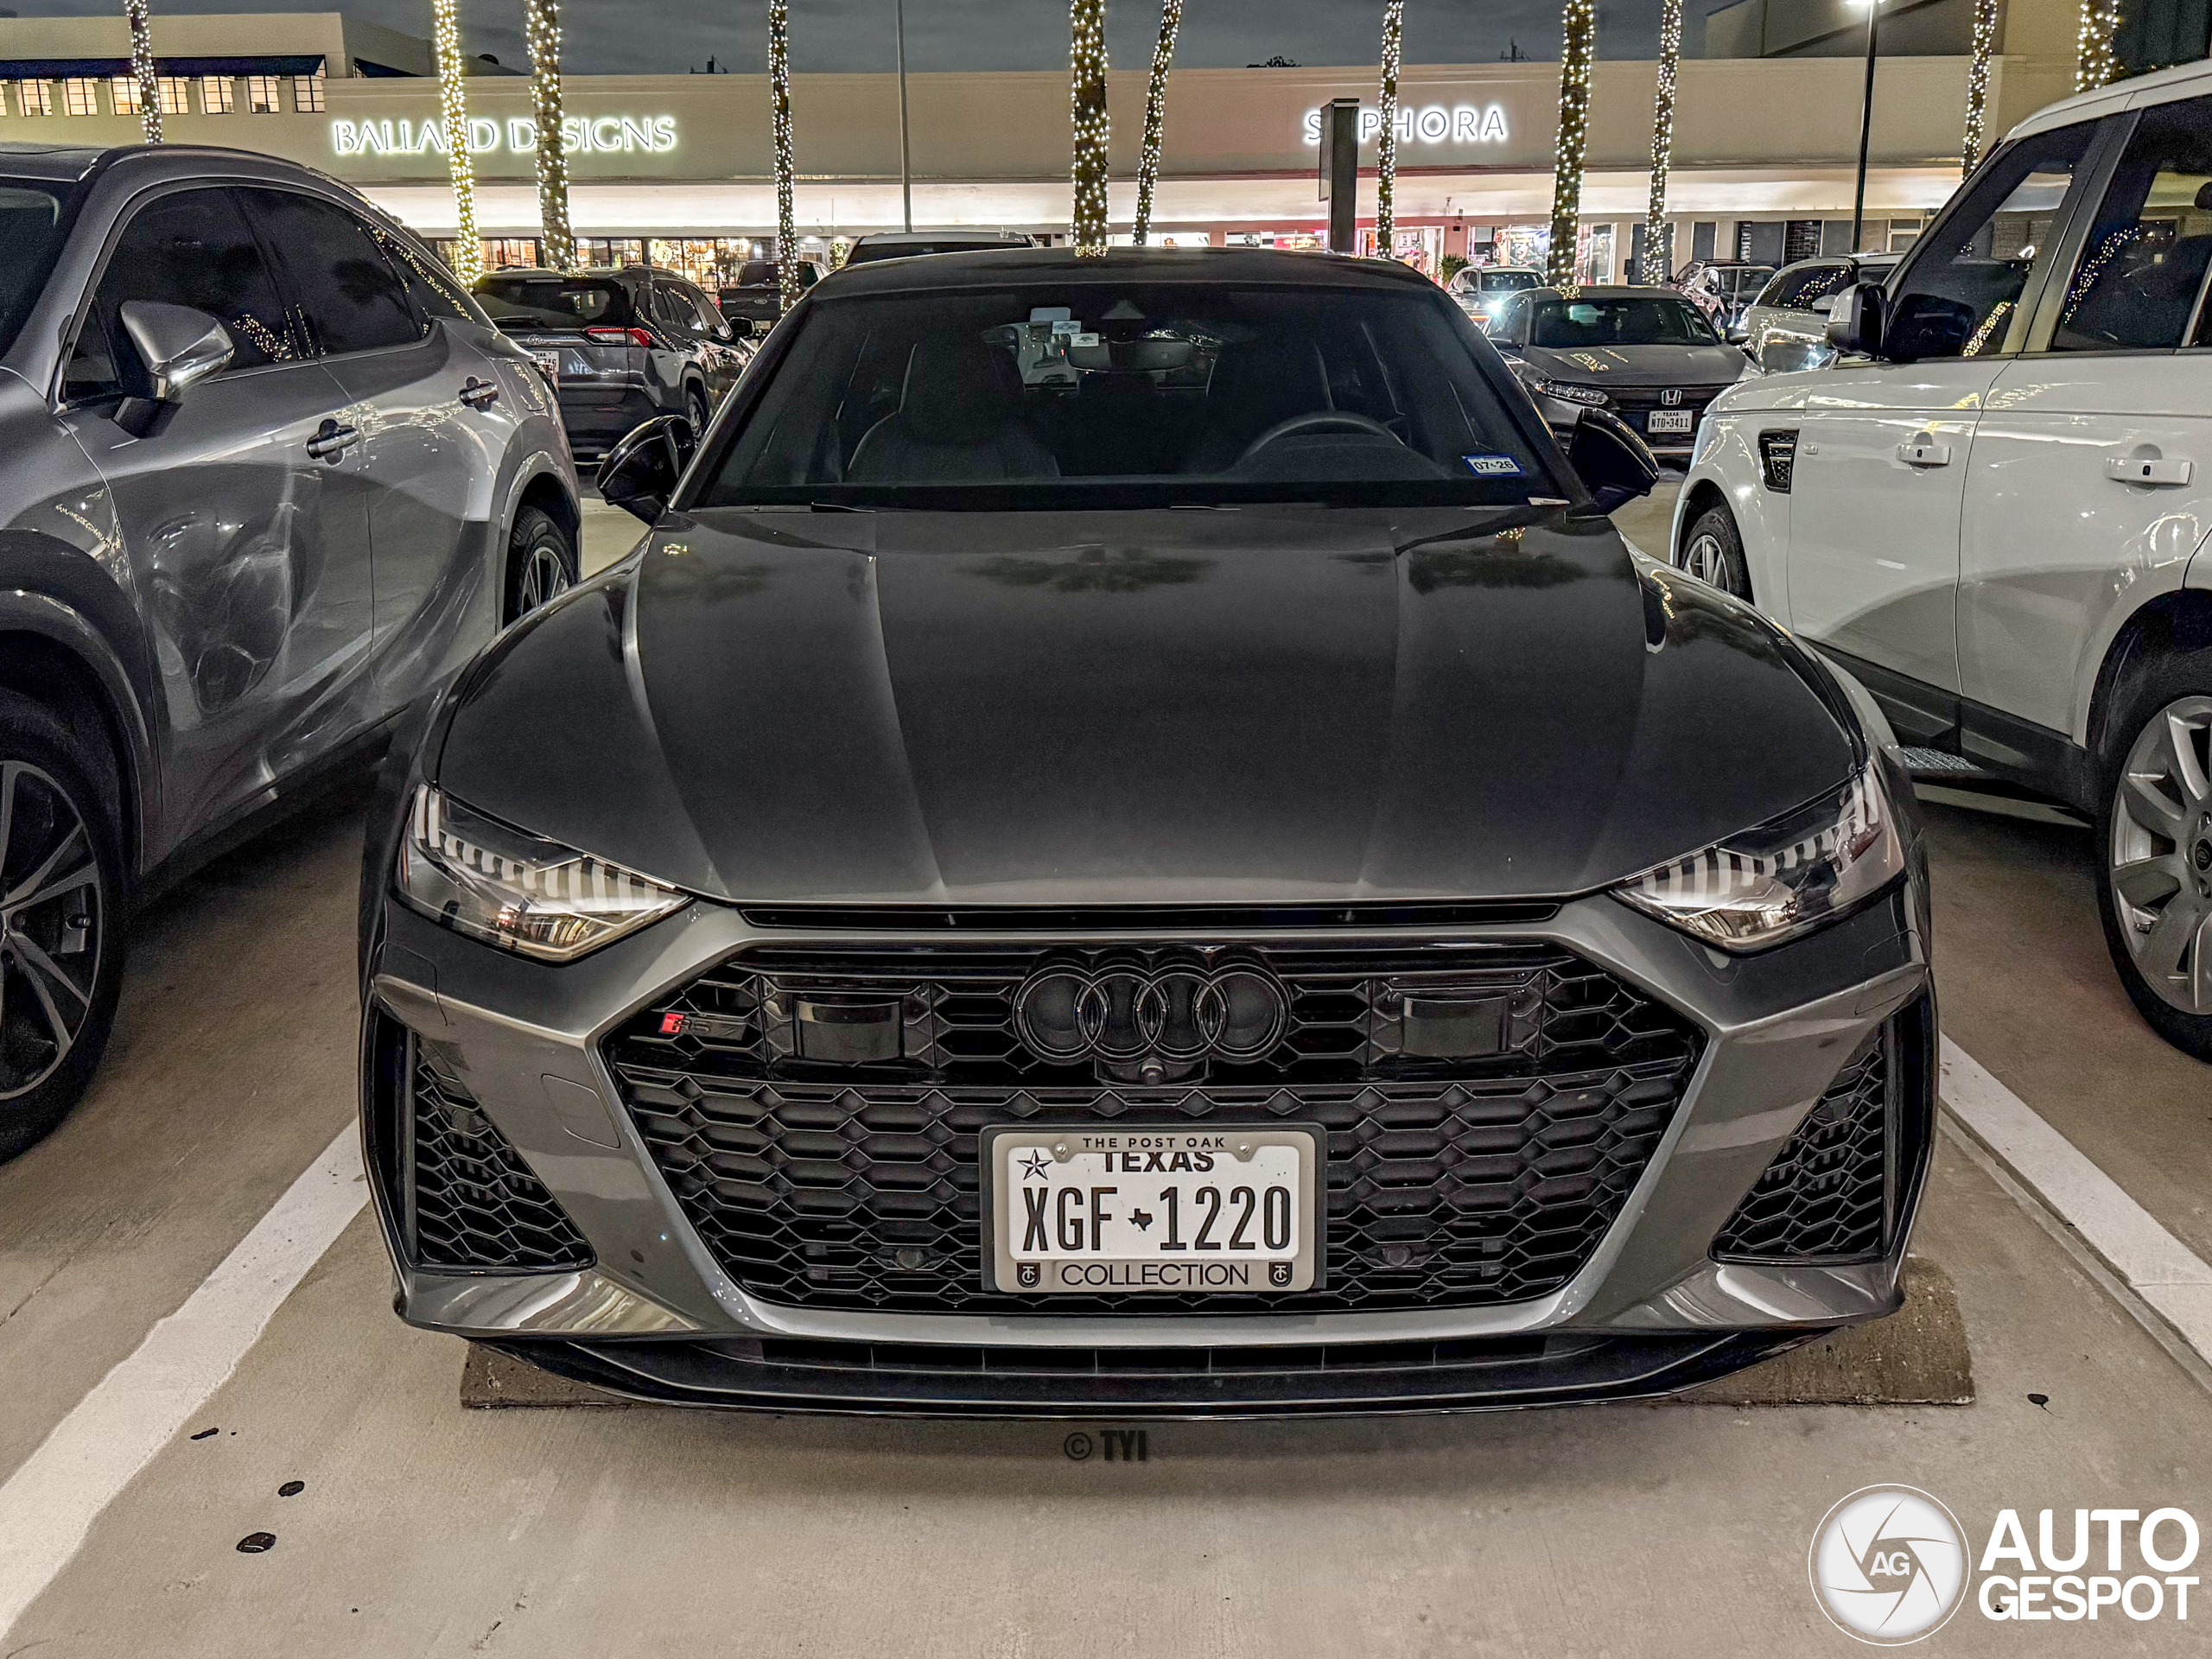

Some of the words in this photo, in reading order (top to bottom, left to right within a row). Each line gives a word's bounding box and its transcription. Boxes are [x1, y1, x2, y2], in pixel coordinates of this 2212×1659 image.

[334, 122, 497, 152] BALLAD
[510, 118, 675, 150] DSIGNS
[1306, 108, 1506, 142] SPHORA
[1083, 1137, 1118, 1148] THE
[1128, 1136, 1176, 1148] POST
[1185, 1136, 1225, 1148] OAK
[1098, 1151, 1216, 1173] TEXAS
[1060, 1263, 1249, 1286] COLLECTION
